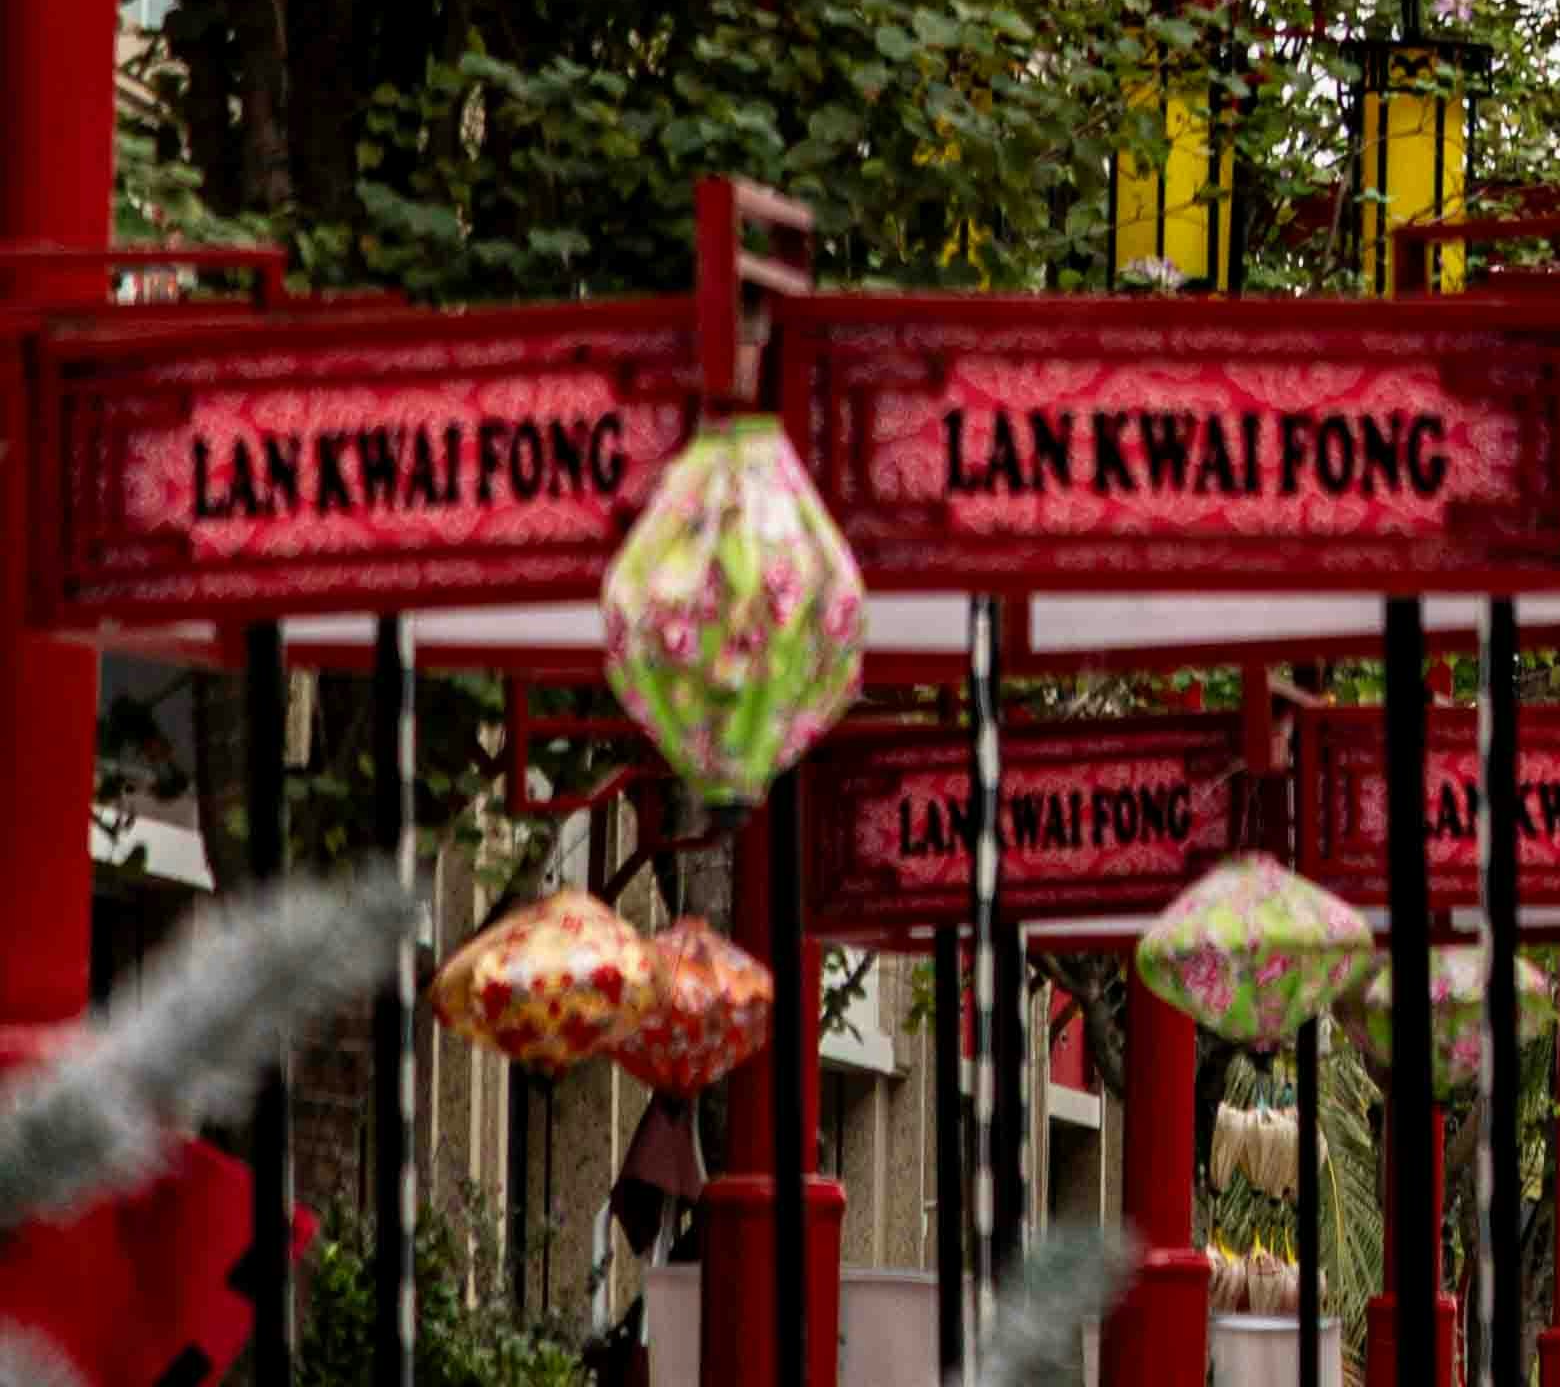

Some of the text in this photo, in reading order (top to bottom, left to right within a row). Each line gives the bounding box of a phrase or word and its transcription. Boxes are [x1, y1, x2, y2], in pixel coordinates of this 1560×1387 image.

[194, 411, 627, 519] LAN KWAI FONG
[944, 408, 1449, 495] LAN KWAI FONG
[997, 788, 1082, 851] WAI
[1092, 783, 1191, 845] FONG
